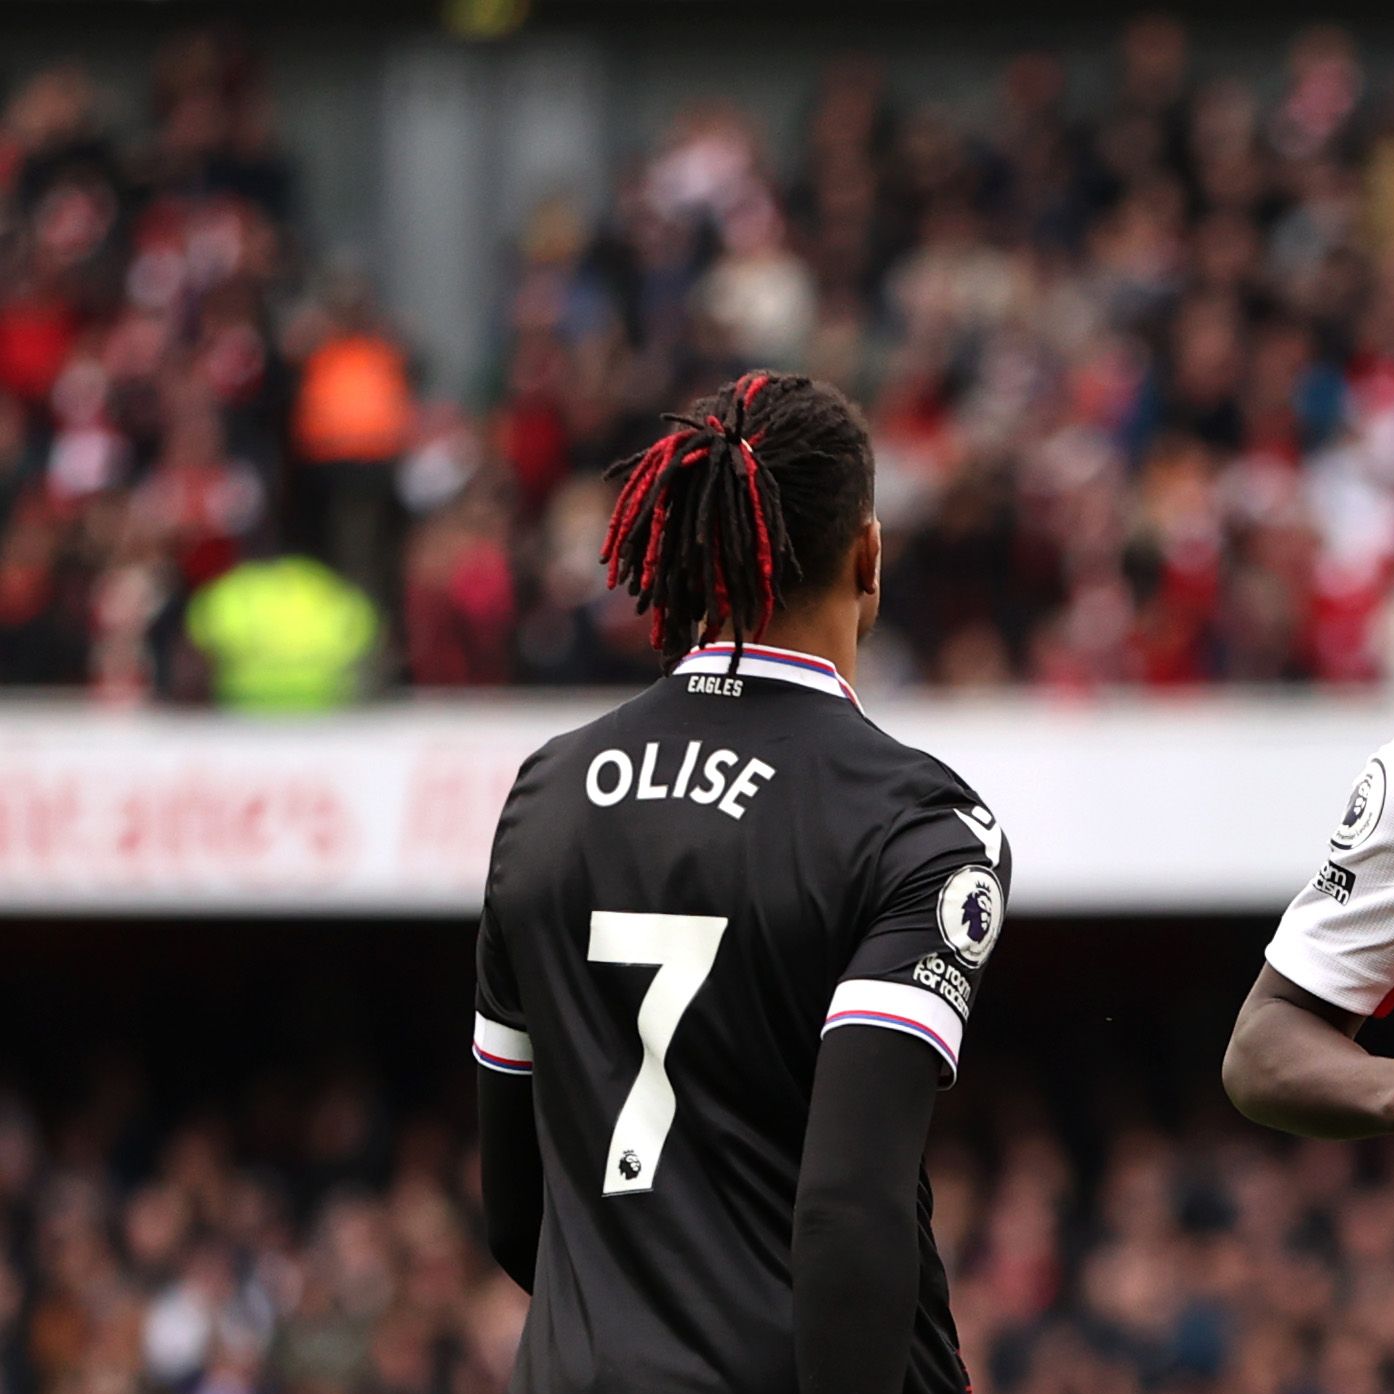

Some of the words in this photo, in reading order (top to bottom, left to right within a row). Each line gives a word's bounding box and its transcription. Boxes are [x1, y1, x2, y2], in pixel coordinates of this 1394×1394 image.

[687, 675, 743, 697] EAGLES
[586, 741, 775, 820] OLISE
[1316, 877, 1350, 906] cism
[587, 911, 728, 1197] 7
